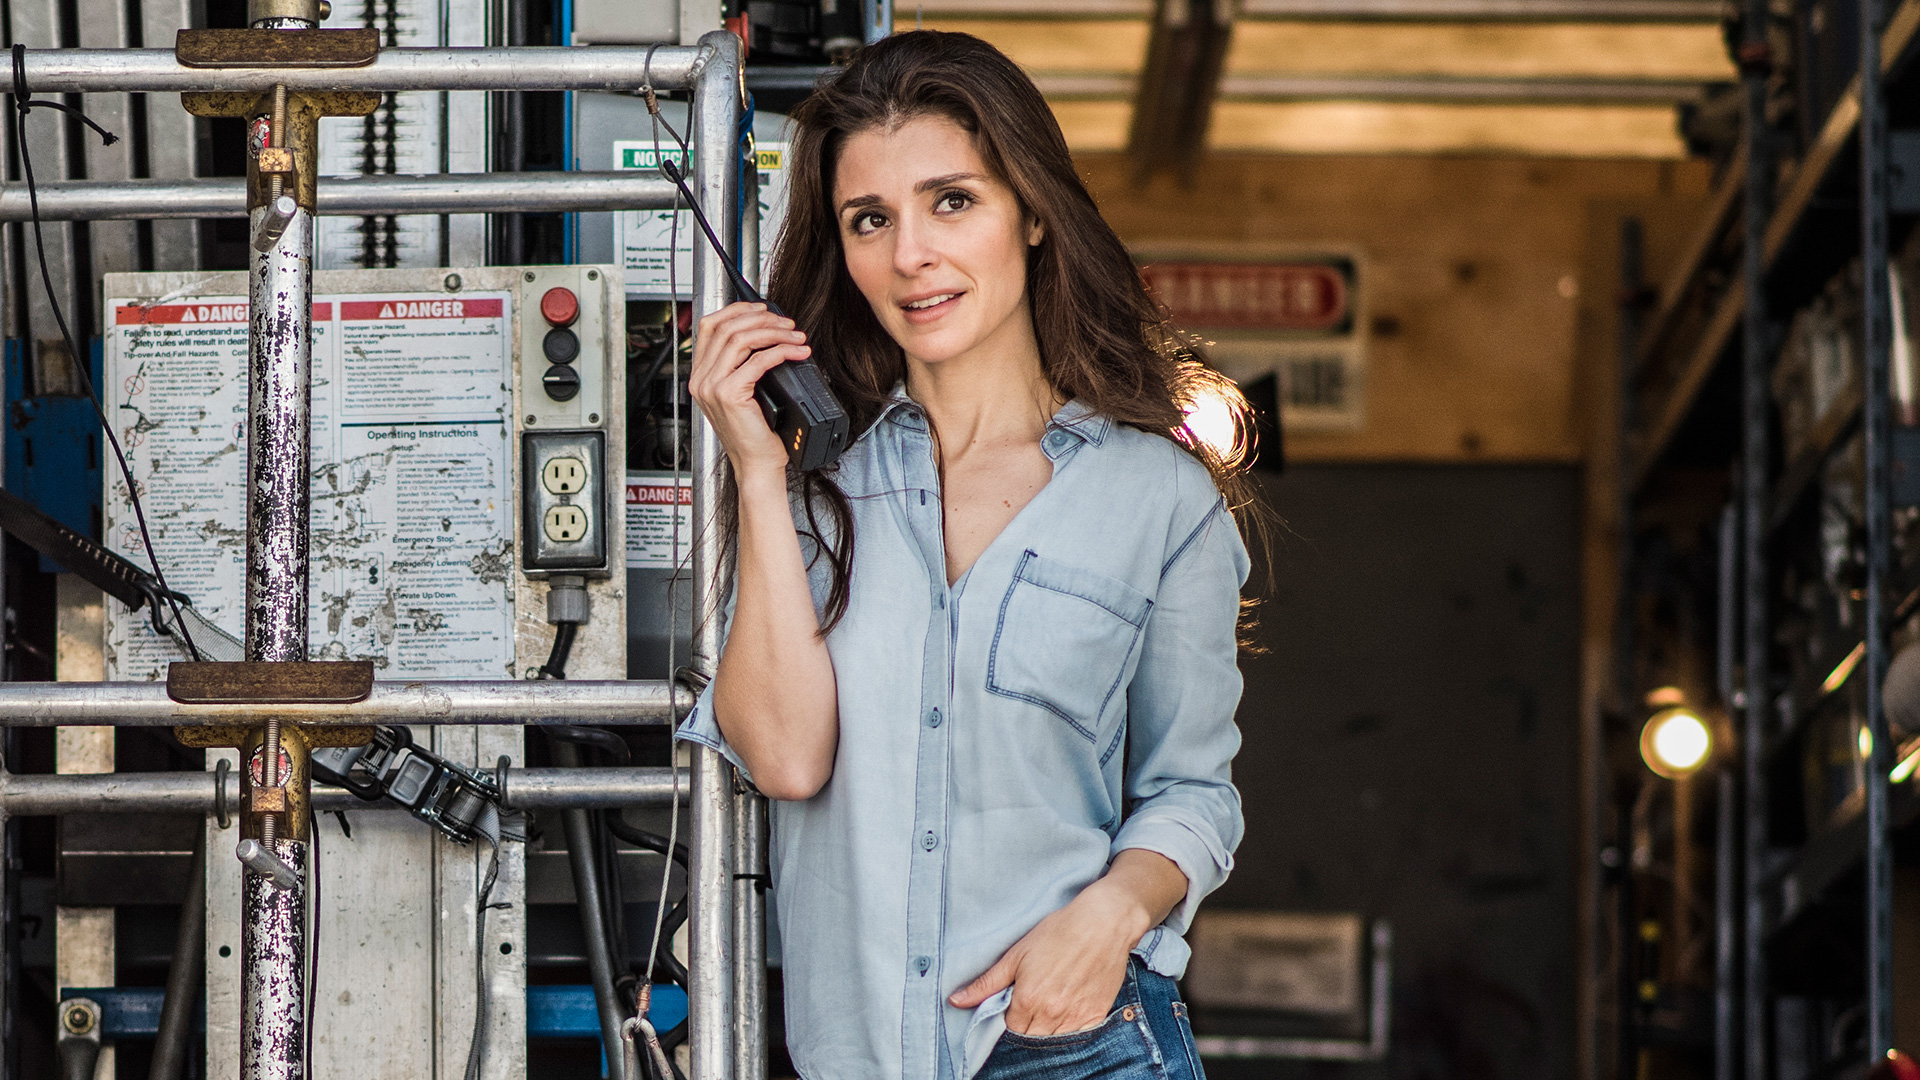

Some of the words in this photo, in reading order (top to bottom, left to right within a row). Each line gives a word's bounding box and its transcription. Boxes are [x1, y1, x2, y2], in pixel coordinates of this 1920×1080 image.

[396, 302, 464, 317] DANGER
[185, 328, 231, 336] understand
[367, 430, 416, 440] Operating
[420, 430, 478, 438] Instructions
